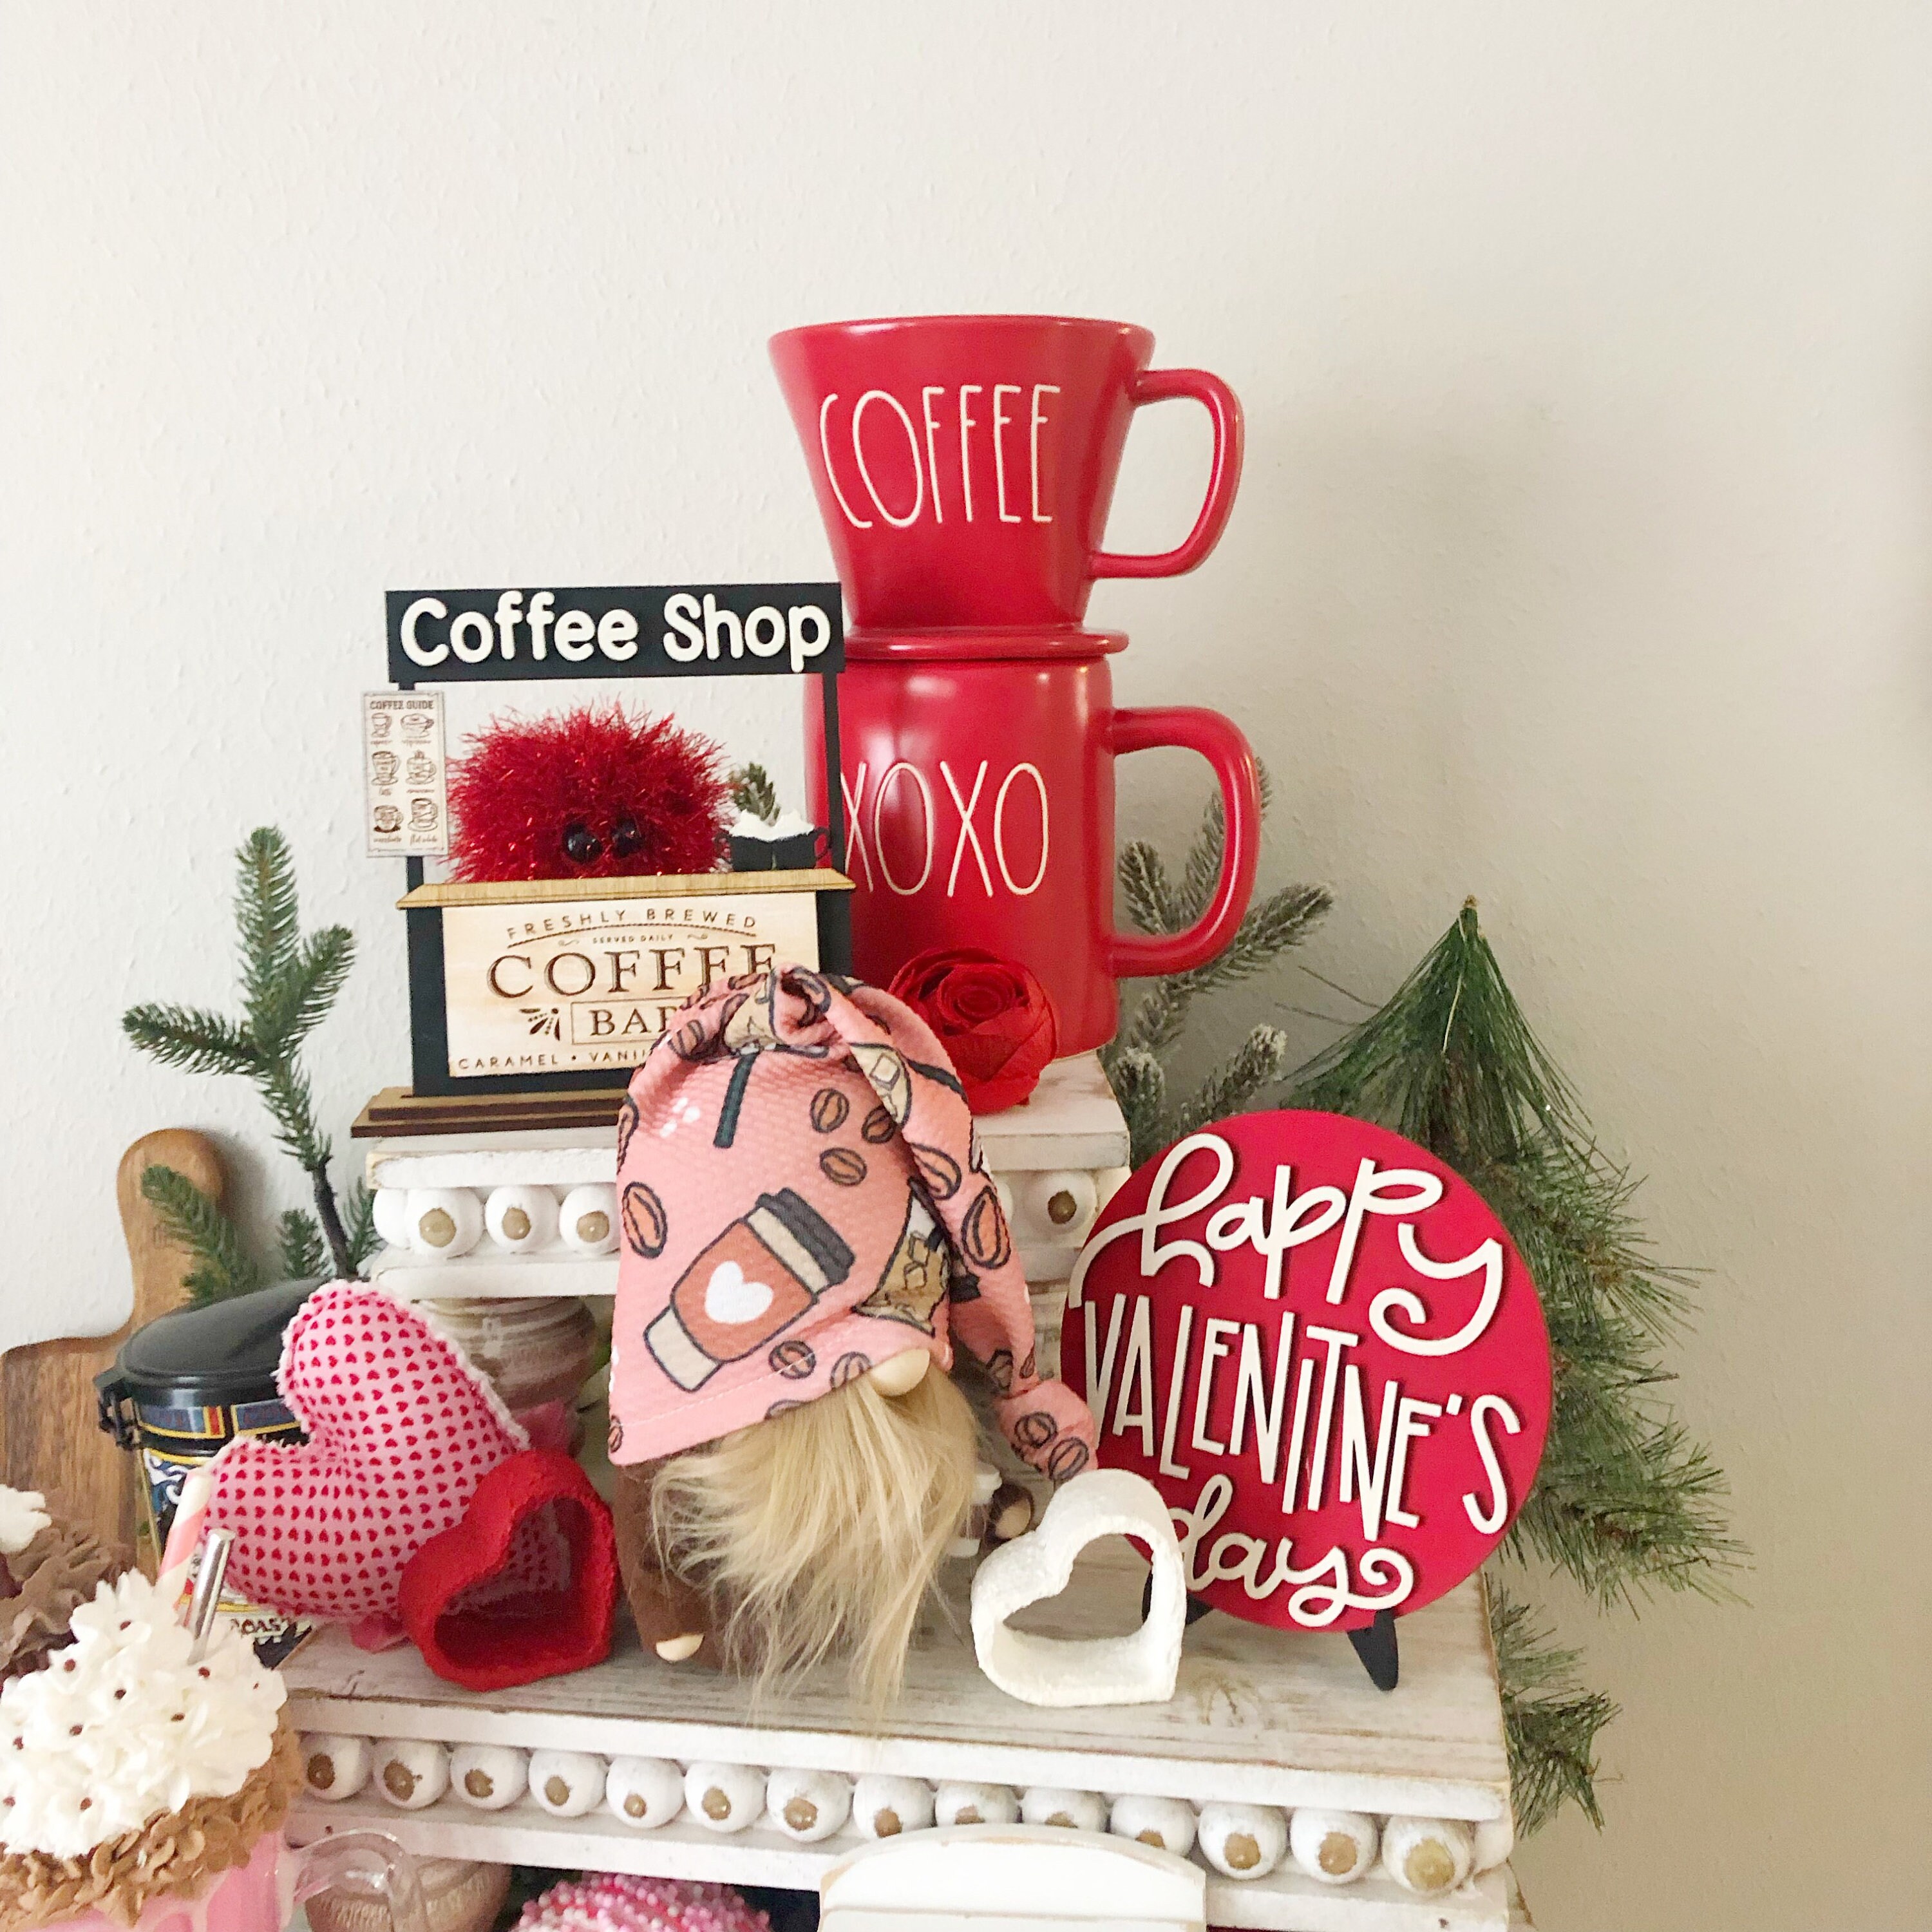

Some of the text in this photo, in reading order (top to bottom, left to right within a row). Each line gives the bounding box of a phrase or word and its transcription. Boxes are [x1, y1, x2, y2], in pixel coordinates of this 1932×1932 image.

[820, 384, 1061, 528] COFFEE
[400, 590, 831, 674] Coffee Shop
[370, 700, 435, 710] COFFEE GUIDE
[840, 761, 1049, 896] XOXO
[507, 909, 757, 940] FRESHLY BREWED
[592, 934, 674, 944] SERVED DAILY
[459, 1054, 559, 1070] CARAMEL
[1069, 1133, 1503, 1356] happy
[1169, 1474, 1414, 1627] day
